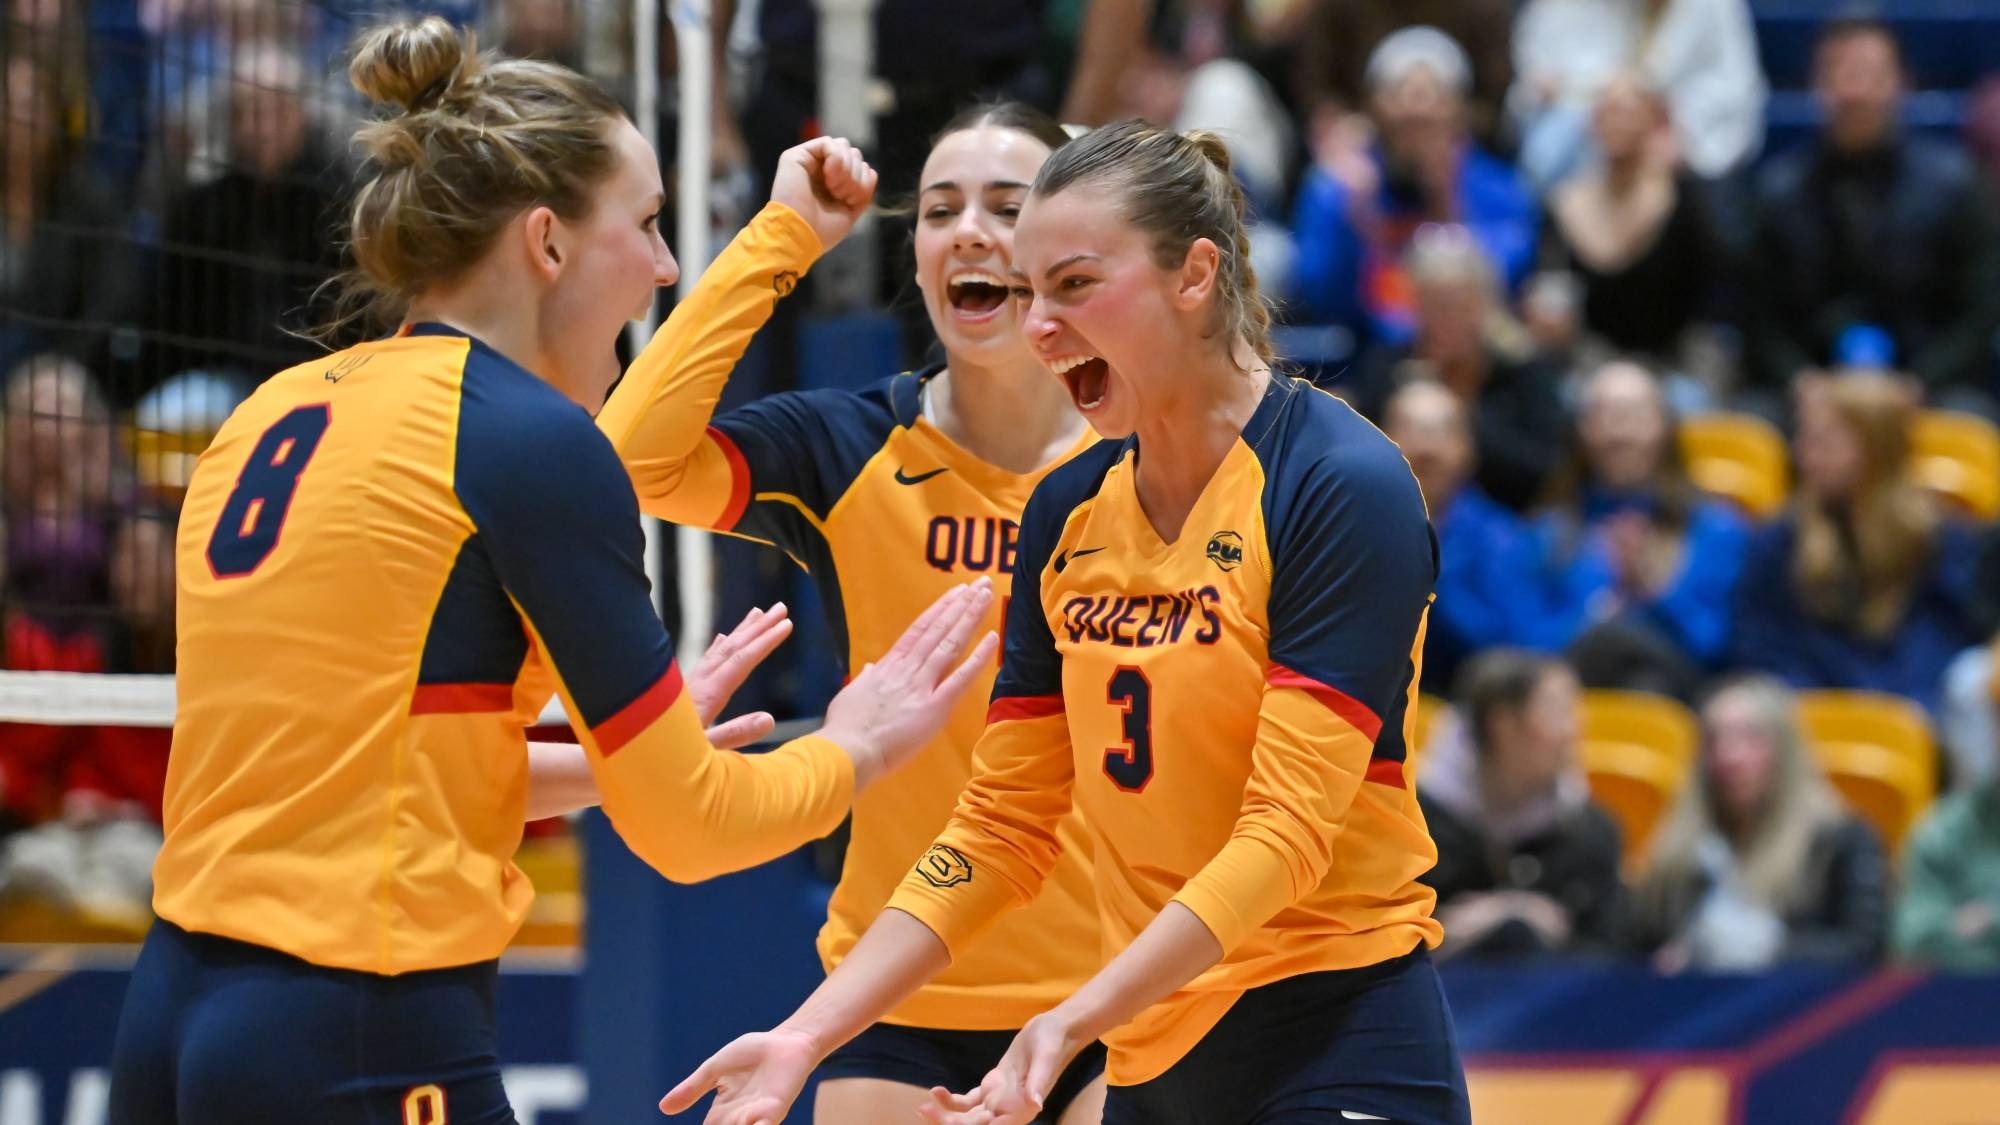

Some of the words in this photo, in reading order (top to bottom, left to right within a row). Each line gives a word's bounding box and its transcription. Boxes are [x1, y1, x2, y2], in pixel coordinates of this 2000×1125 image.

[205, 402, 332, 580] 8
[1062, 585, 1221, 648] QUEEN'S
[1102, 664, 1154, 794] 3
